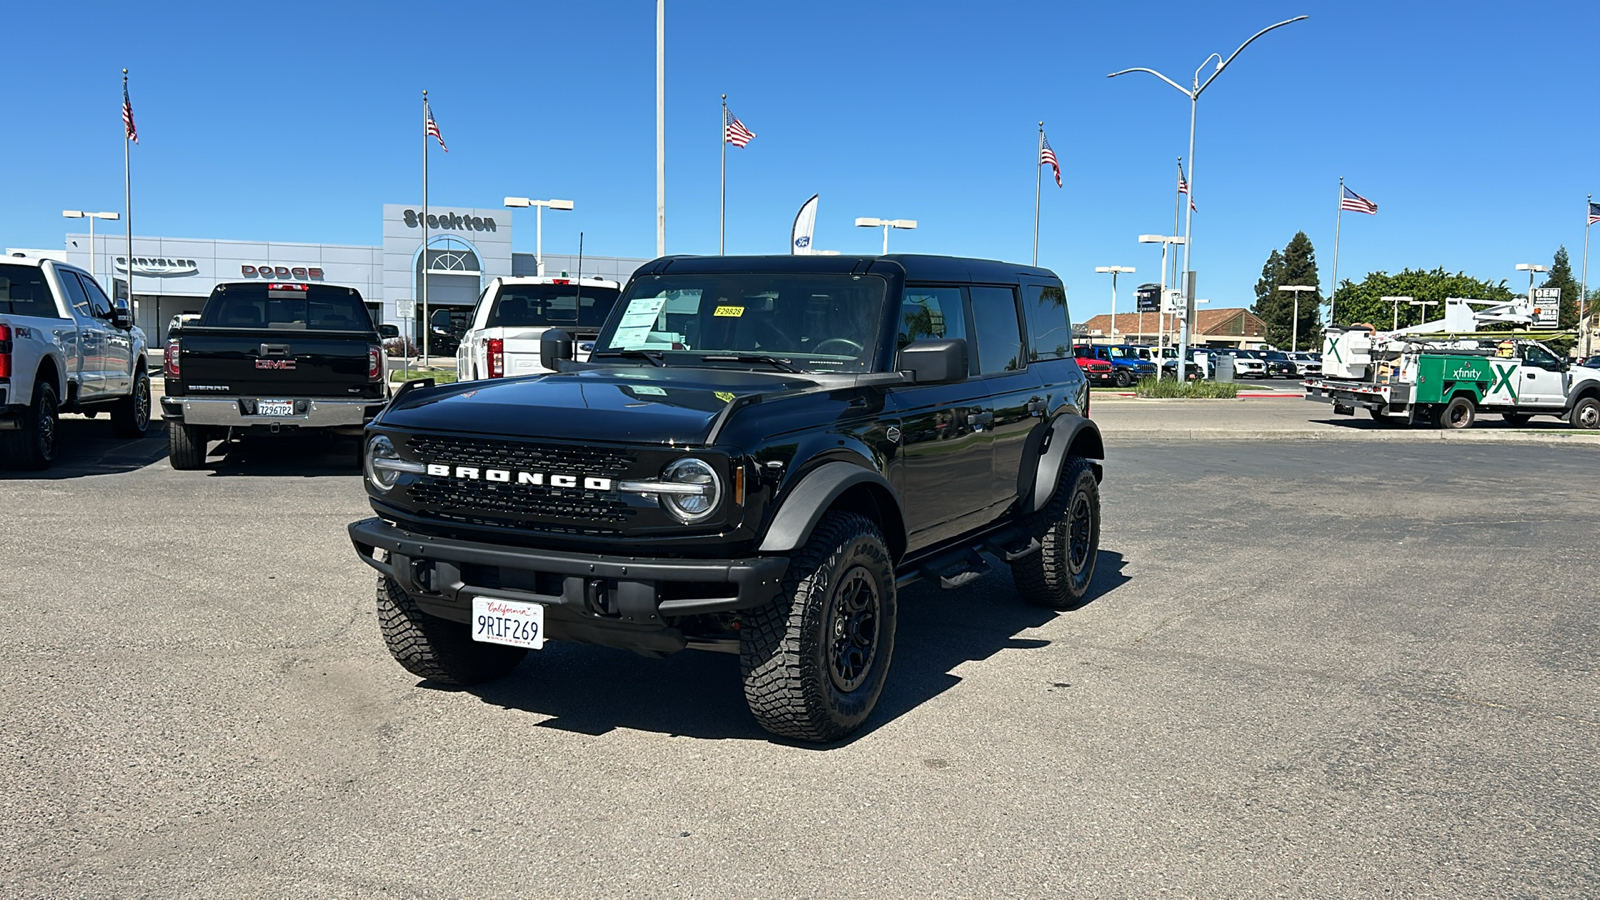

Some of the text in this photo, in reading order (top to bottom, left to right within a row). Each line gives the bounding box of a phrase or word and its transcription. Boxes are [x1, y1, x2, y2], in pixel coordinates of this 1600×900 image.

[241, 265, 323, 279] DODGE
[1535, 289, 1558, 297] OEM
[715, 307, 742, 316] F29828
[255, 359, 296, 370] GMC
[1453, 367, 1481, 380] xfinity
[260, 405, 292, 416] 72967P2
[427, 463, 612, 491] BRONCO
[488, 601, 531, 616] California
[477, 614, 539, 642] 9RIF269
